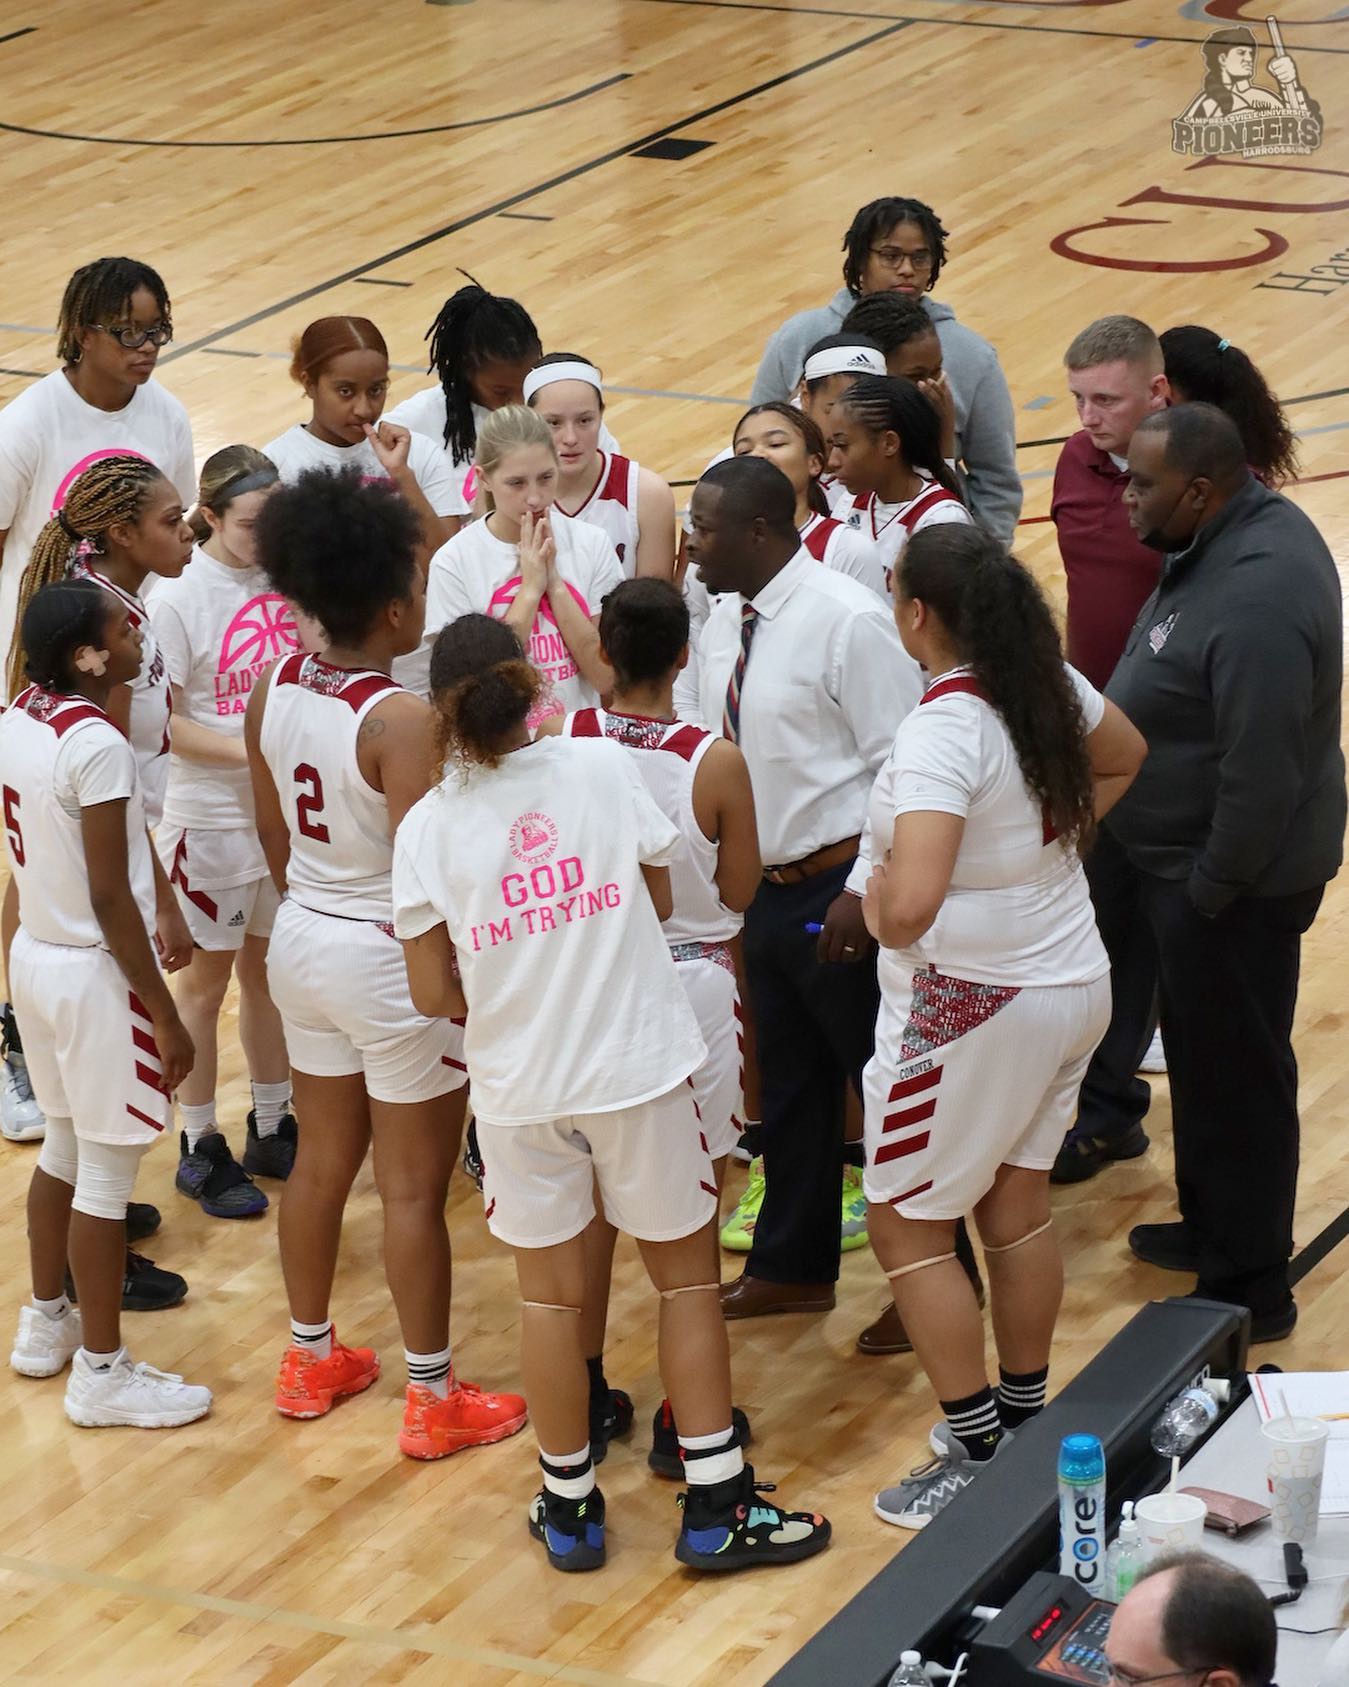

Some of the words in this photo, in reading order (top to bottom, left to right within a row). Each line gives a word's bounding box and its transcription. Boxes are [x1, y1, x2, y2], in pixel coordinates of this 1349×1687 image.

[3, 784, 26, 868] 5
[294, 762, 331, 844] 2
[471, 917, 513, 951] I'M
[520, 883, 620, 934] TRYING
[501, 857, 584, 908] GOD
[1073, 1497, 1099, 1584] core
